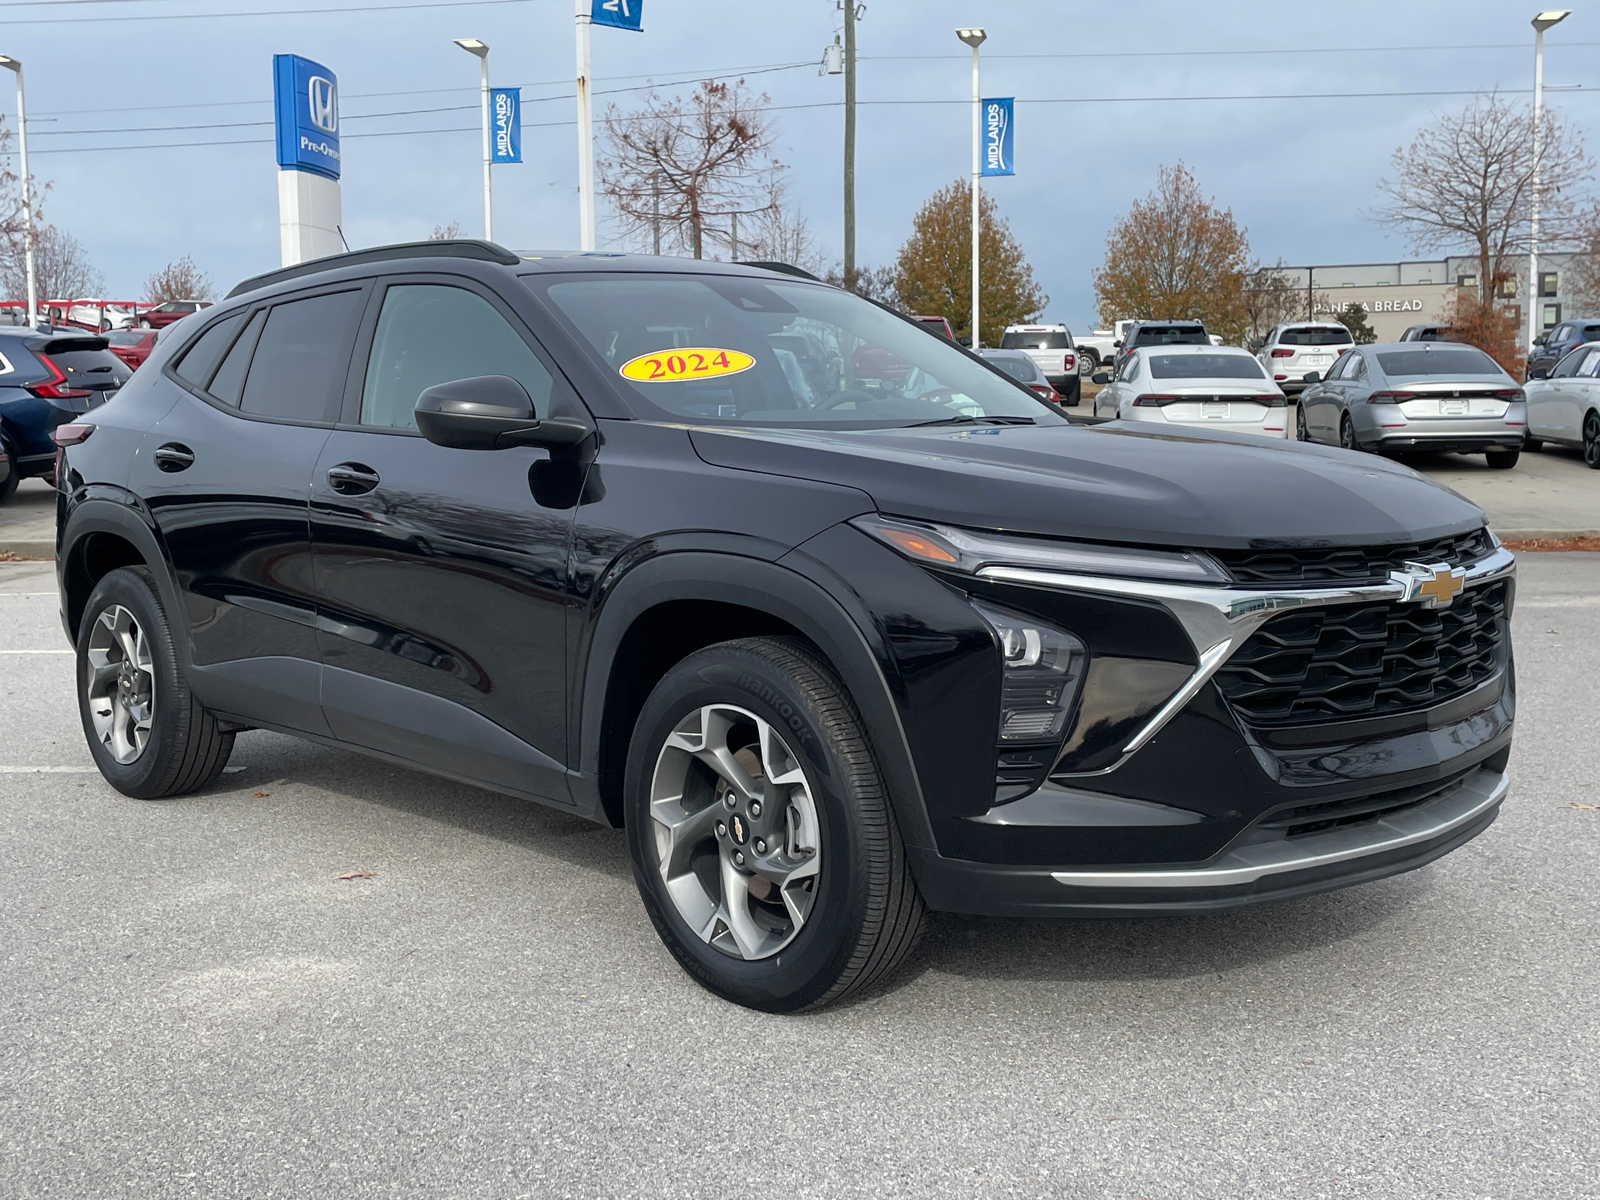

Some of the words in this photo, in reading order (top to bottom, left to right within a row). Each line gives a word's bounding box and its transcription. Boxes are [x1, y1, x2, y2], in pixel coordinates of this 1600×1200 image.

[496, 93, 507, 156] MIDLANDS
[987, 104, 999, 169] MIDLANDS
[1313, 301, 1370, 314] PANEA
[1375, 300, 1422, 312] BREAD
[644, 351, 731, 379] 2024
